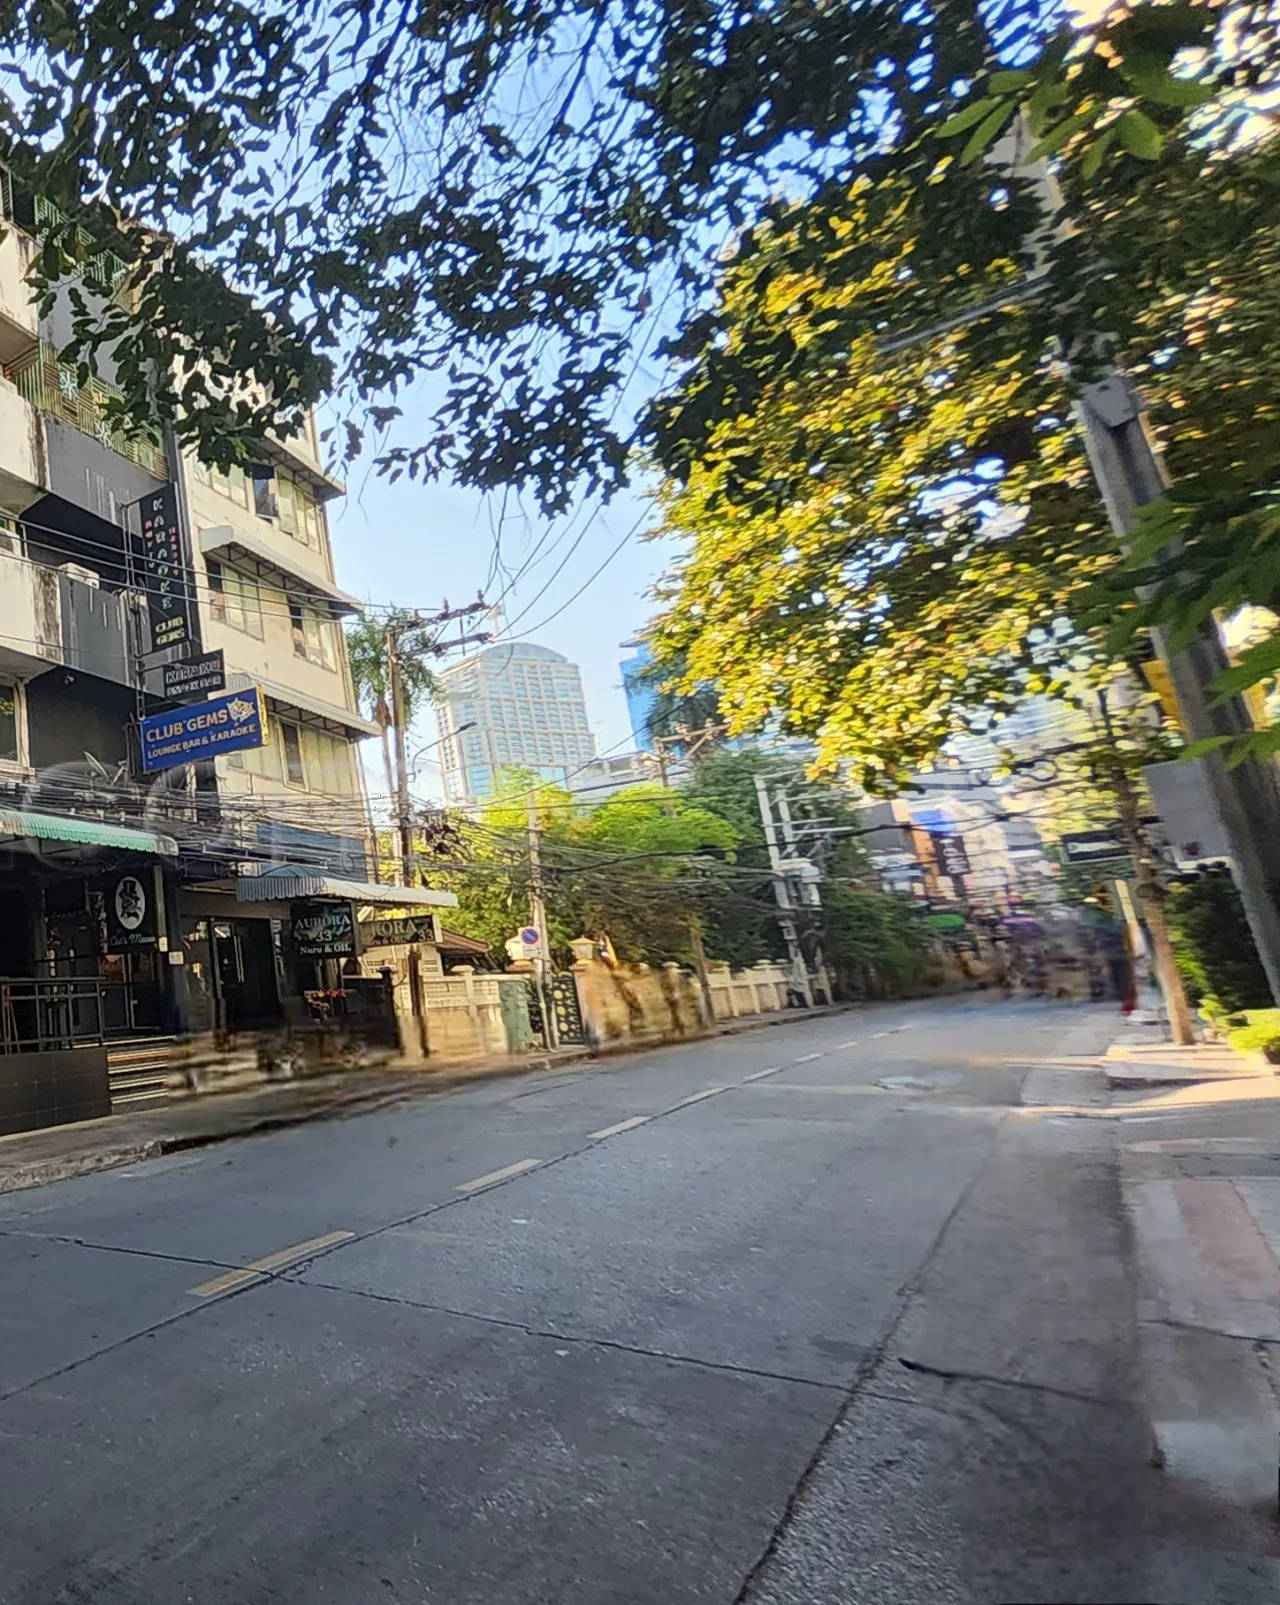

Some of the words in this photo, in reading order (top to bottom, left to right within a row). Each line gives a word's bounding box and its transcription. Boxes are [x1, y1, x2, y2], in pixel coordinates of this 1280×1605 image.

[152, 497, 173, 610] KARAOKE
[146, 720, 184, 743] CLUB
[186, 708, 228, 733] GEMS
[147, 743, 182, 759] LOUNGE
[182, 738, 202, 751] BAR
[210, 724, 257, 745] KARAOKE
[295, 914, 351, 930] AURORA
[315, 930, 332, 942] 33
[418, 929, 434, 942] 33
